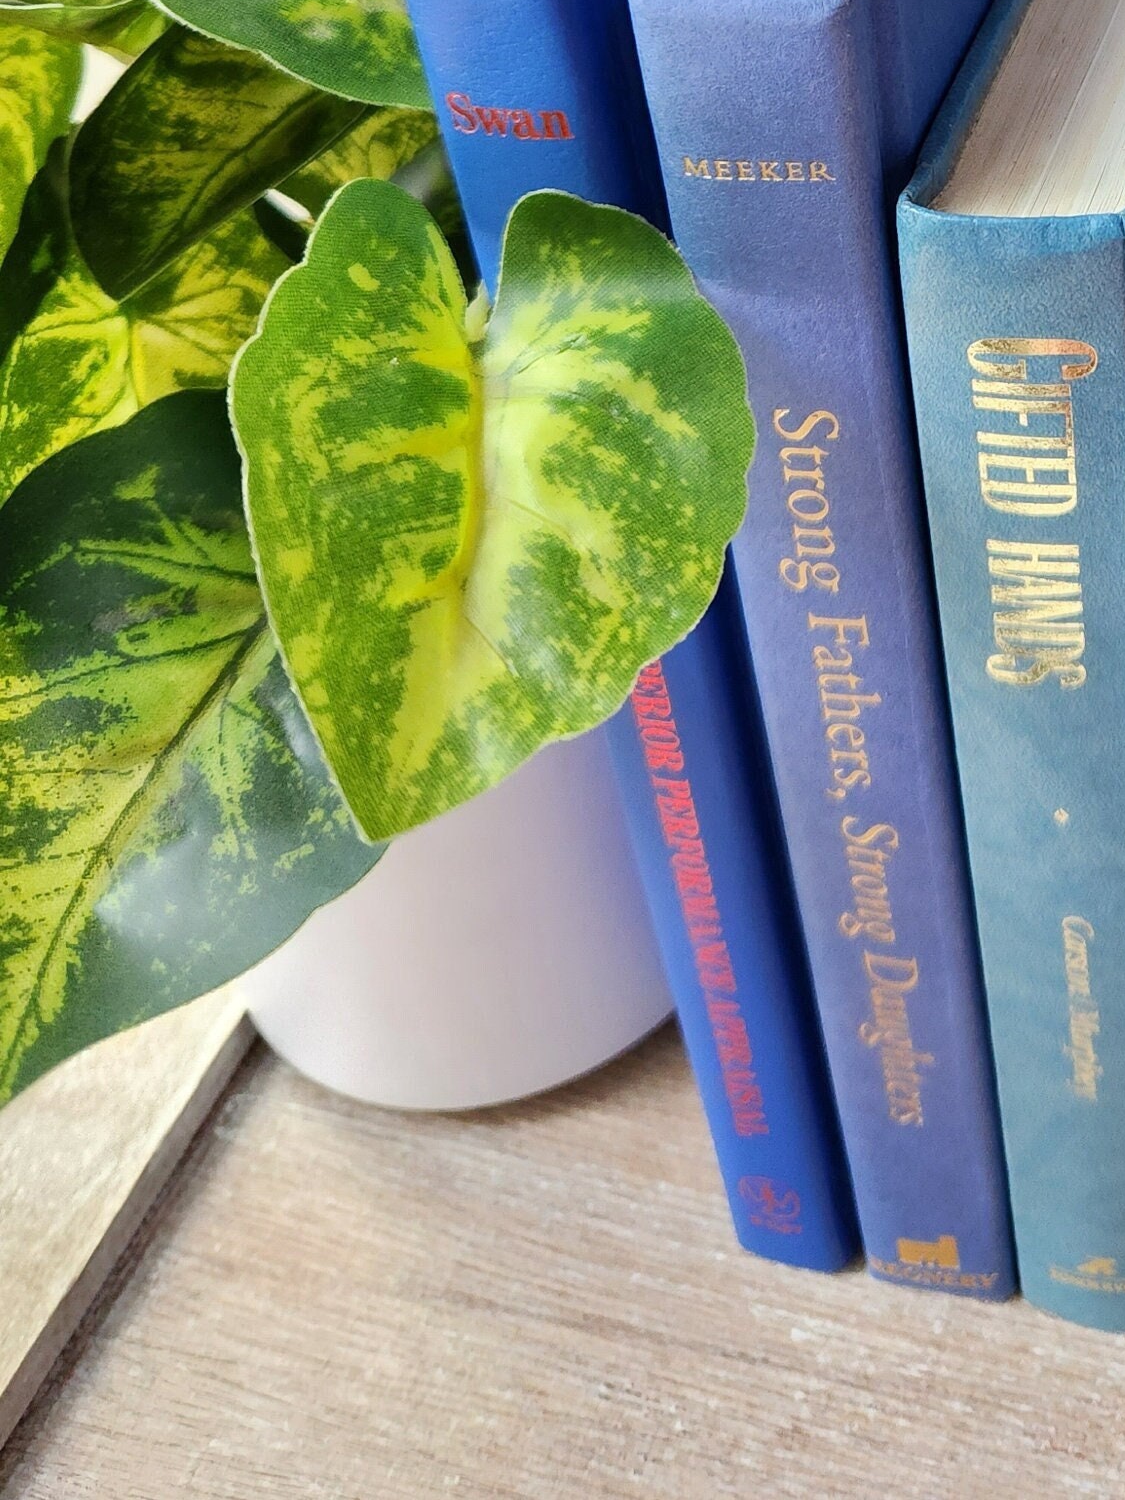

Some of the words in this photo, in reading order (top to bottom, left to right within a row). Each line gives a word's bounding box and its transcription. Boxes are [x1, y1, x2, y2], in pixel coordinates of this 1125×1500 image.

[446, 92, 574, 141] Swan
[683, 156, 835, 183] MEEKER
[774, 409, 839, 593] Strong
[967, 338, 1097, 517] GIFTED
[986, 539, 1086, 688] HANDS
[809, 613, 883, 799] Fathers,
[653, 779, 735, 996] PERFORMANCE
[840, 816, 898, 943] Strong
[859, 950, 934, 1126] Daughters
